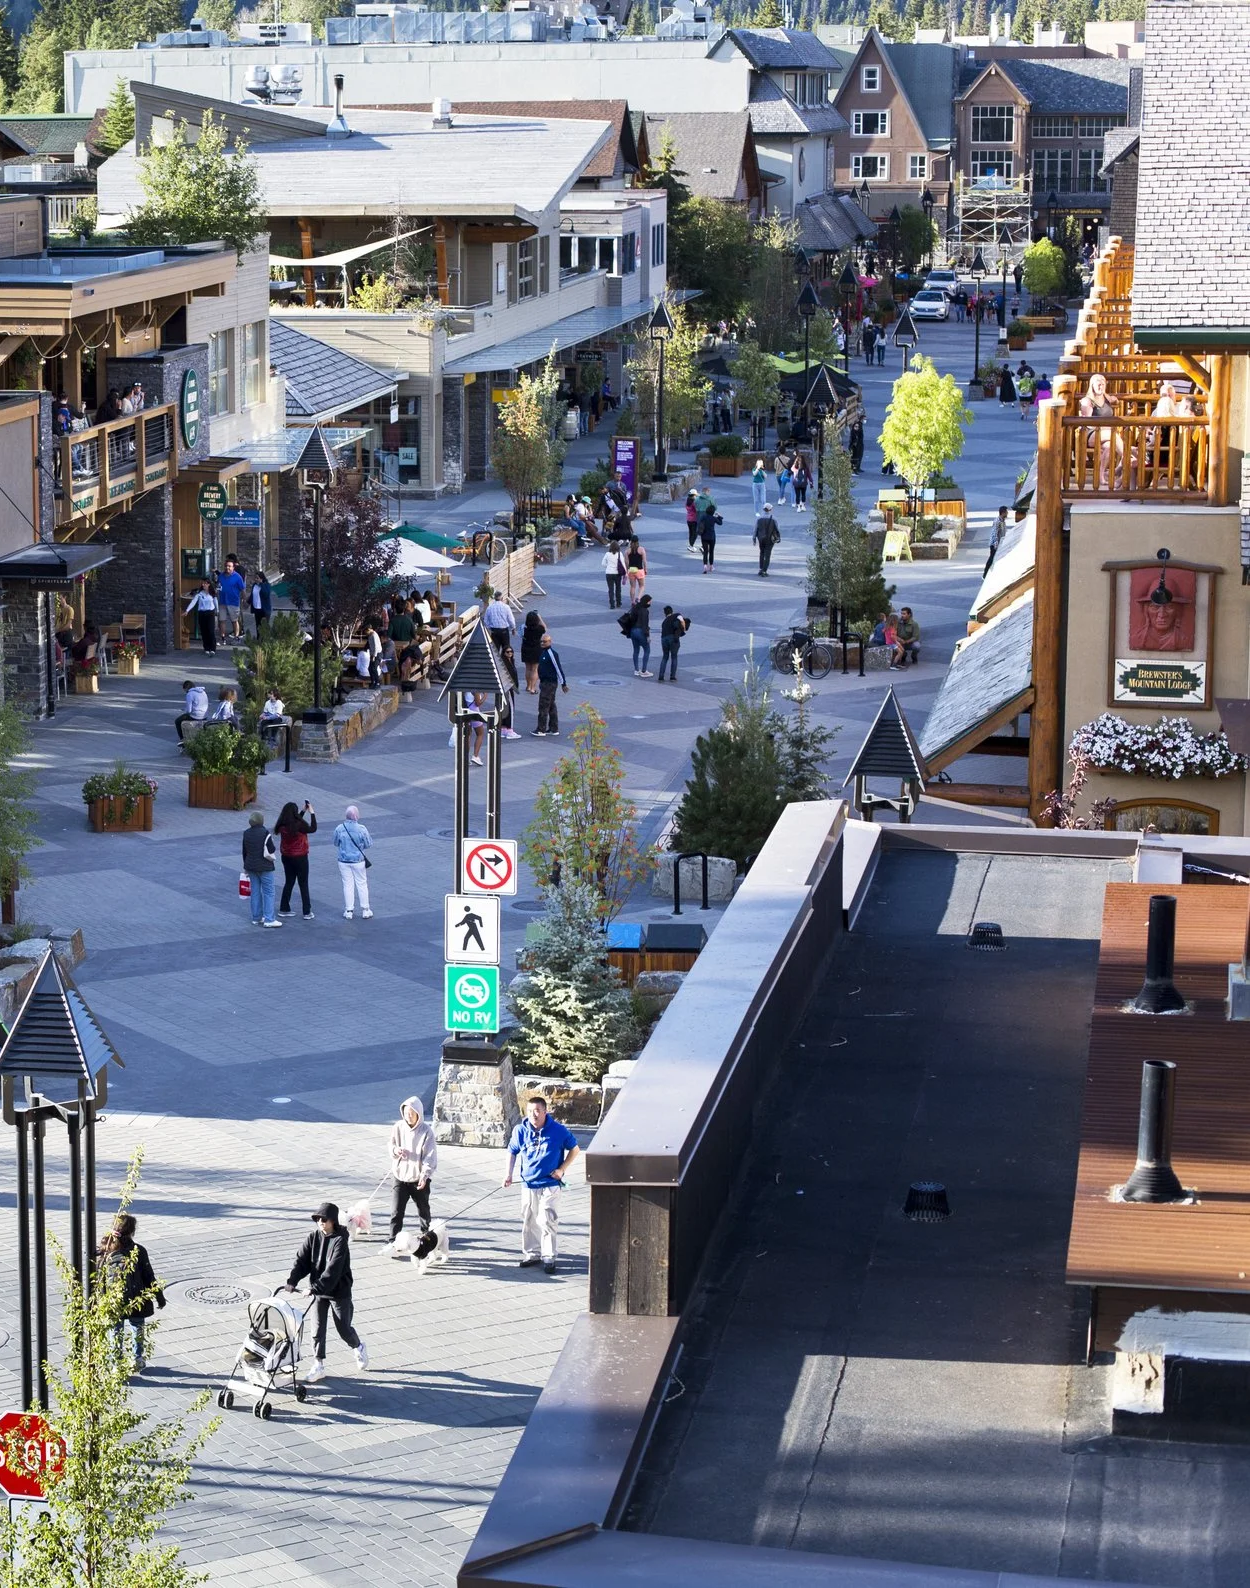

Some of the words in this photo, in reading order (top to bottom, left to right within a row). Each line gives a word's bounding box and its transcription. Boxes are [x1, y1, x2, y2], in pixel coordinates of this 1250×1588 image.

[402, 452, 414, 460] SALE
[1138, 669, 1183, 680] BREWSTER'S
[1128, 678, 1166, 689] MOUNTAIN
[1167, 680, 1192, 690] LODGE
[452, 1010, 470, 1023] NO
[474, 1011, 492, 1024] RV
